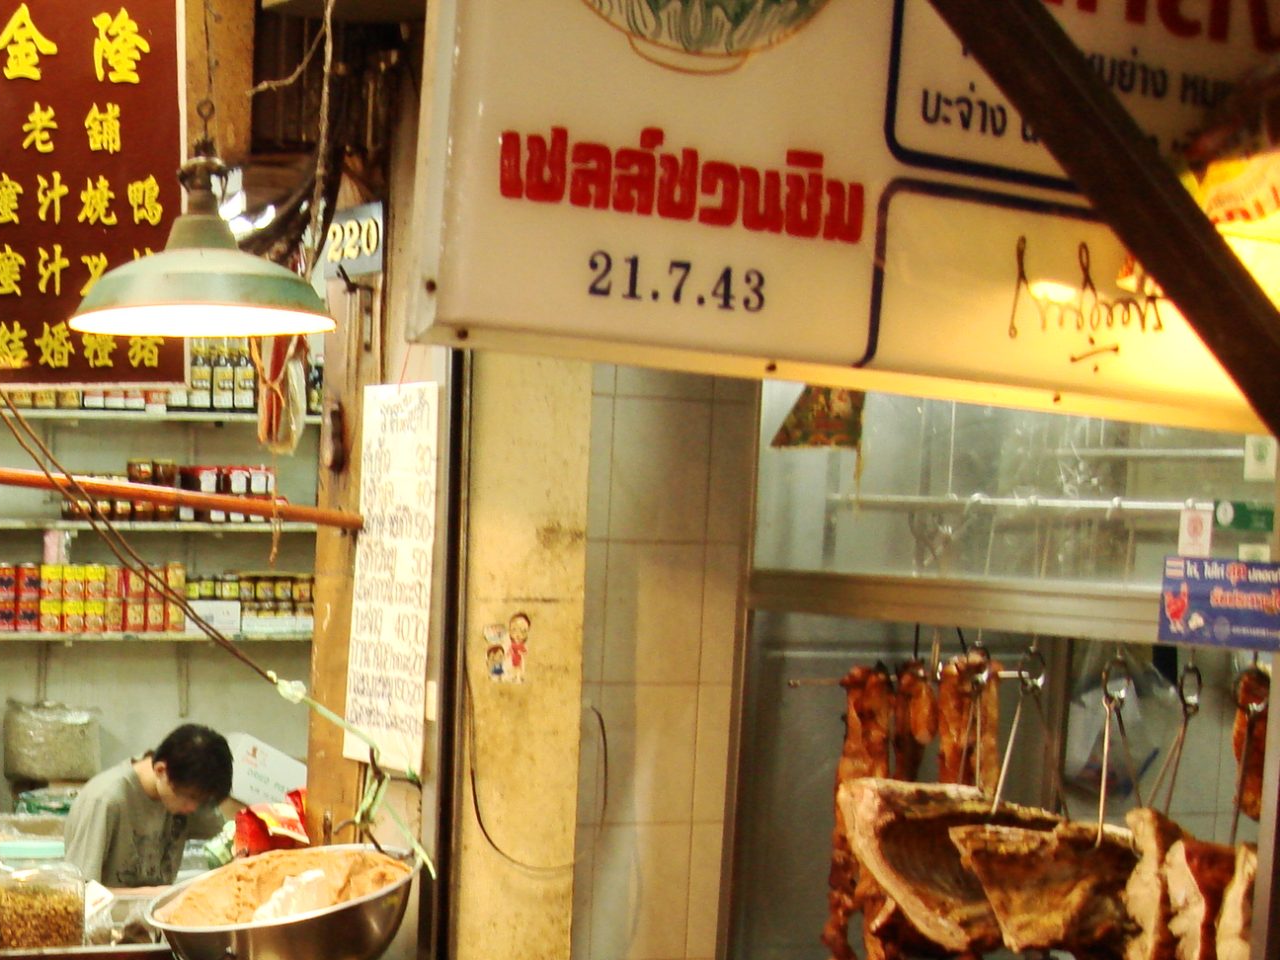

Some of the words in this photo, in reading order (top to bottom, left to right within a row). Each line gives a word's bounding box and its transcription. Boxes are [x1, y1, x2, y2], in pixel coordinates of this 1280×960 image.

[499, 126, 865, 244] เชลล์ชวนชิม
[326, 217, 379, 264] 220
[587, 250, 767, 313] 21.7.43
